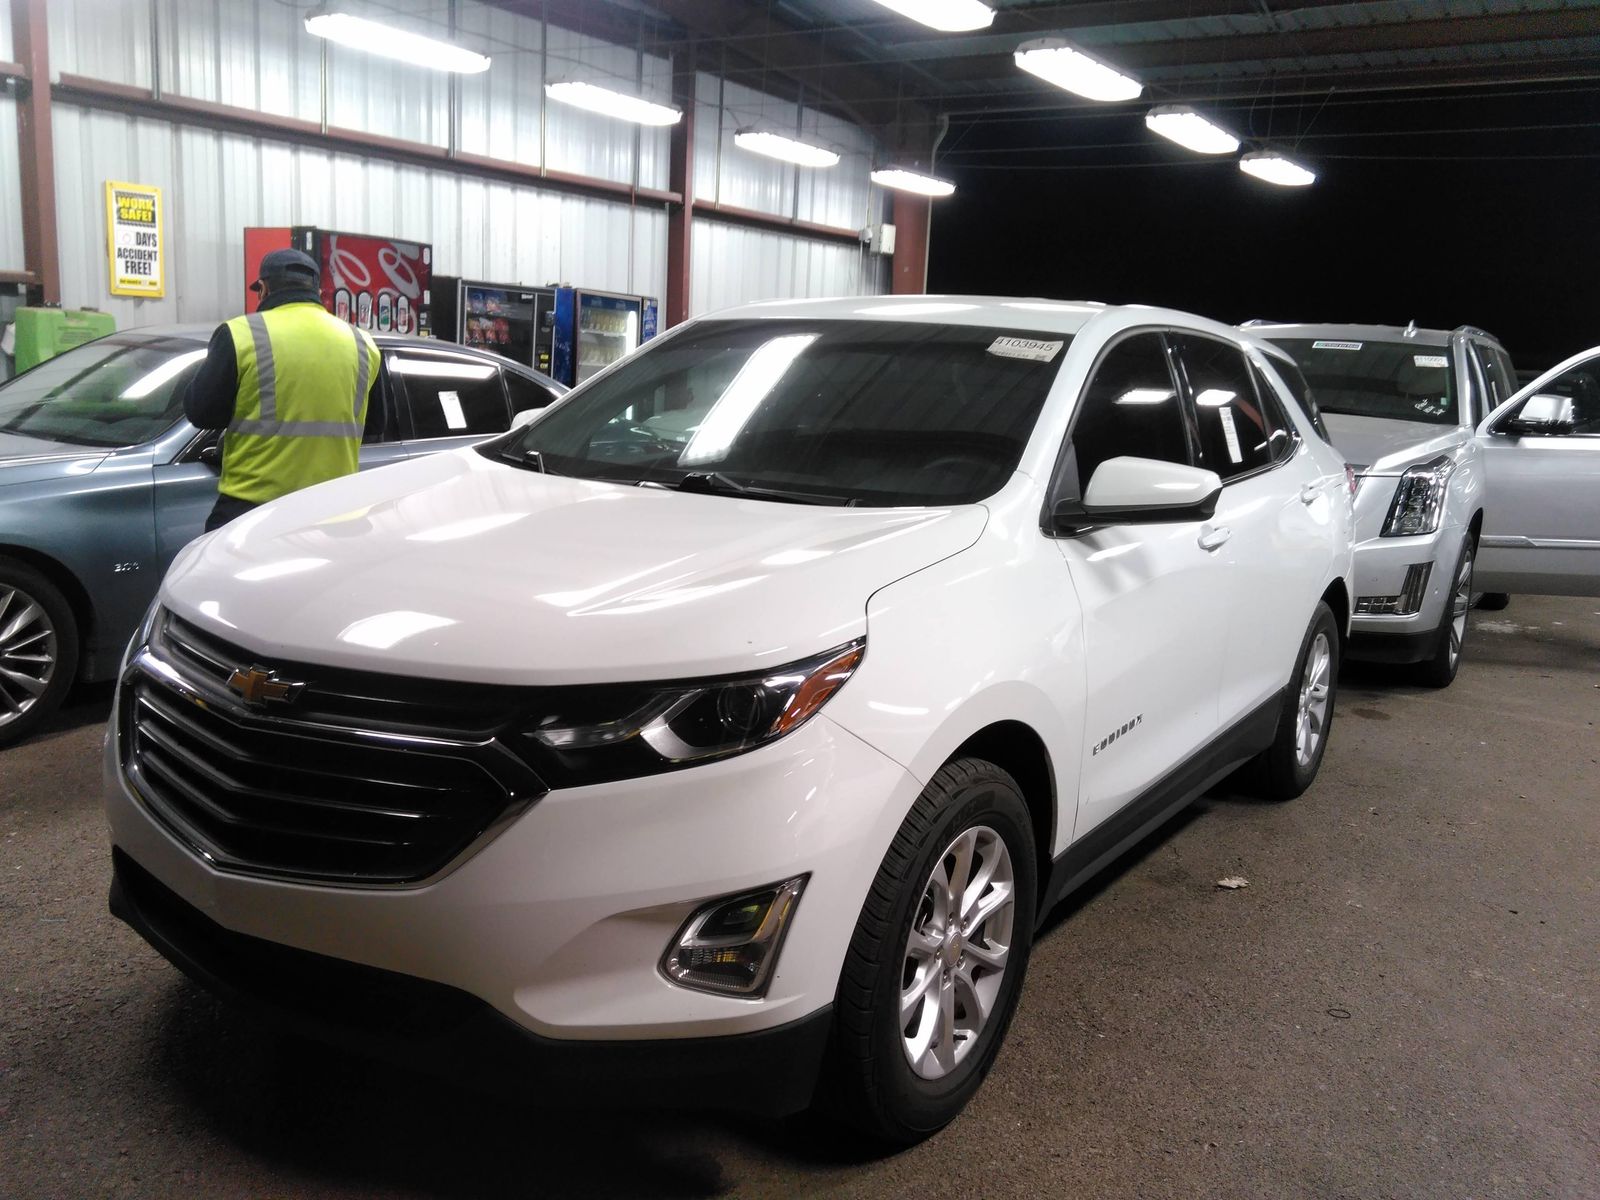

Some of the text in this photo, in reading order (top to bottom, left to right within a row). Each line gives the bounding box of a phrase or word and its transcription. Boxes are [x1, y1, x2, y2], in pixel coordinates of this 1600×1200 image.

[117, 196, 154, 211] WORK
[119, 207, 152, 222] SAFE!
[135, 231, 157, 247] DAYS
[117, 247, 158, 262] ACCIDENT
[125, 260, 152, 276] FREE!
[995, 338, 1055, 352] 4103945
